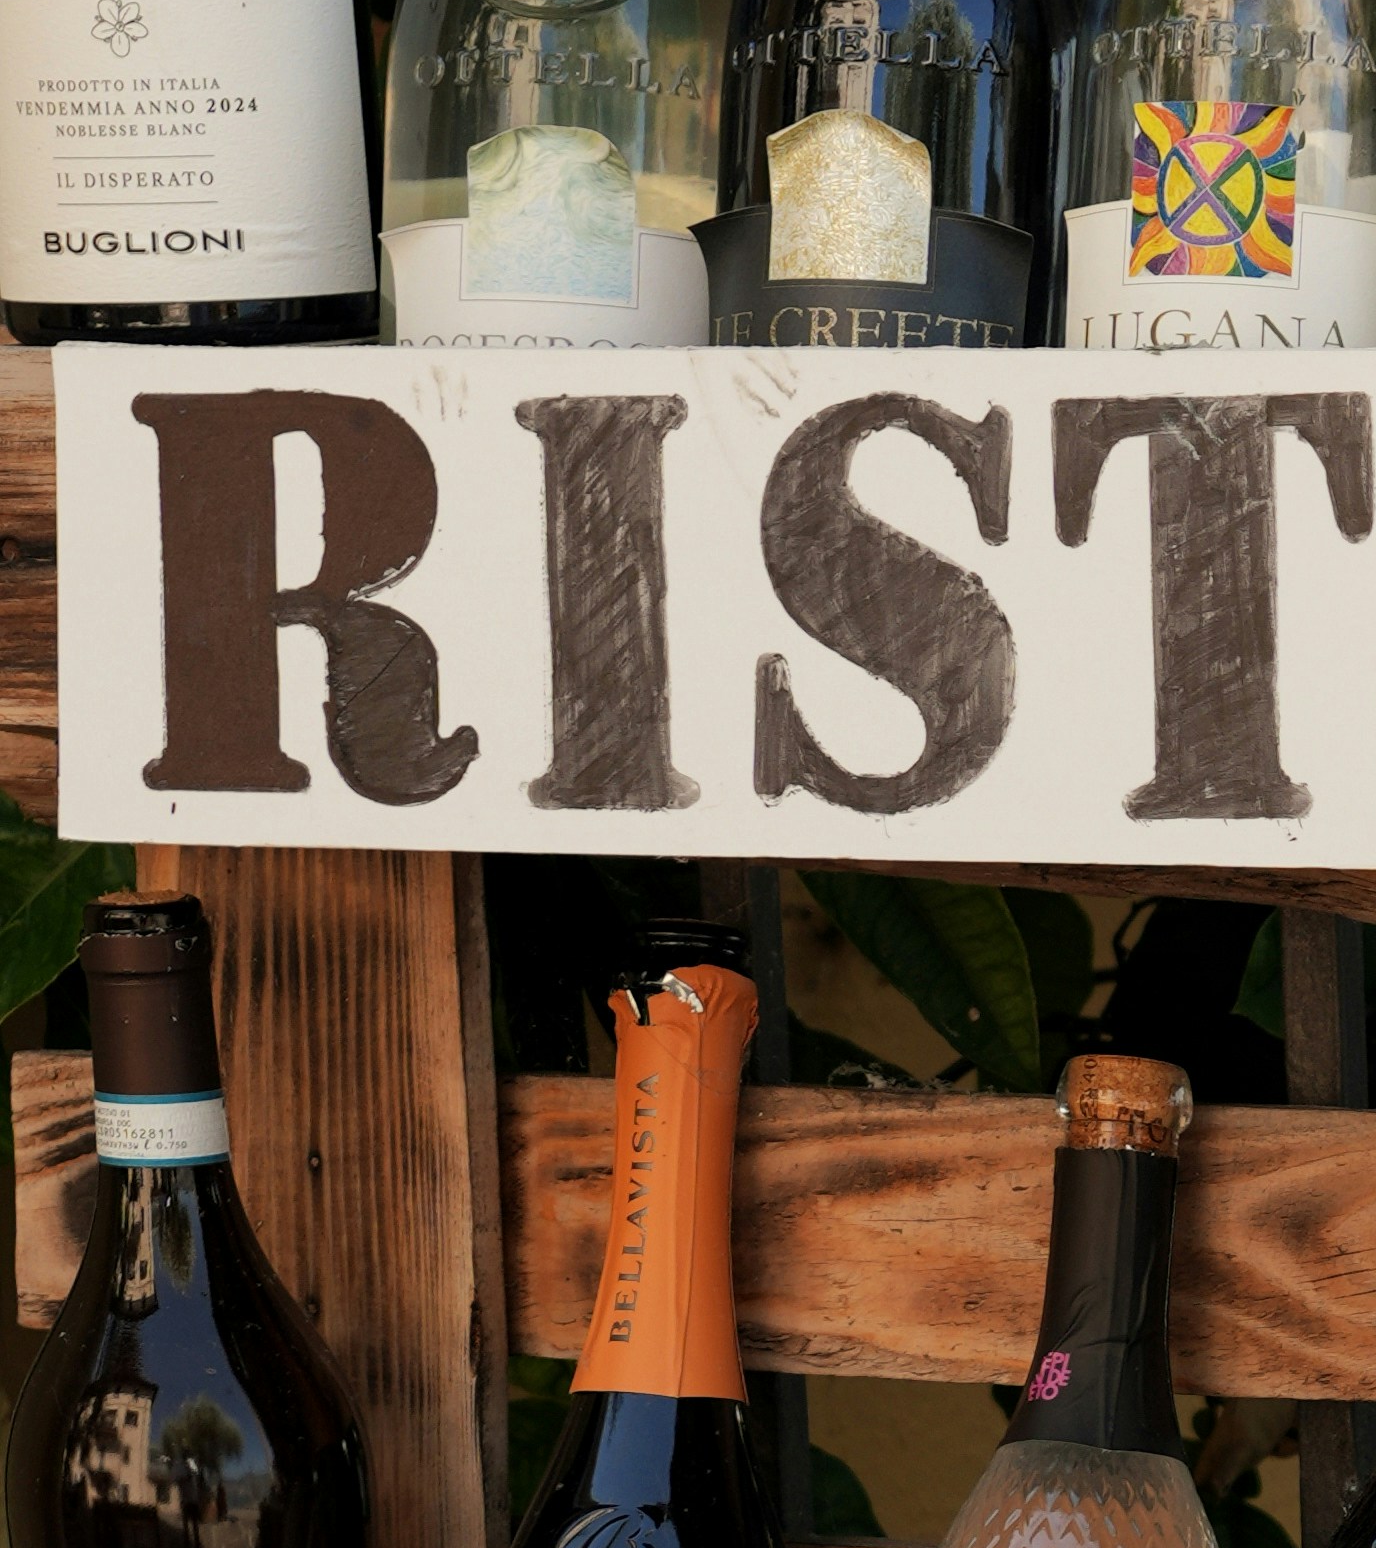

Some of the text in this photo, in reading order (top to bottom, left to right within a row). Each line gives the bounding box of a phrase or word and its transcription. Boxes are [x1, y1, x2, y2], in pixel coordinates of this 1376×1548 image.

[37, 77, 222, 93] PRODOTTO IN ITALIA
[15, 96, 259, 117] VENDEMMIA ANNO 2024
[54, 122, 208, 138] NOBLESSE BLANC
[56, 170, 215, 189] IL DISPERATO
[43, 228, 247, 255] BUGLIONI
[607, 1070, 662, 1345] BELLAVISTA
